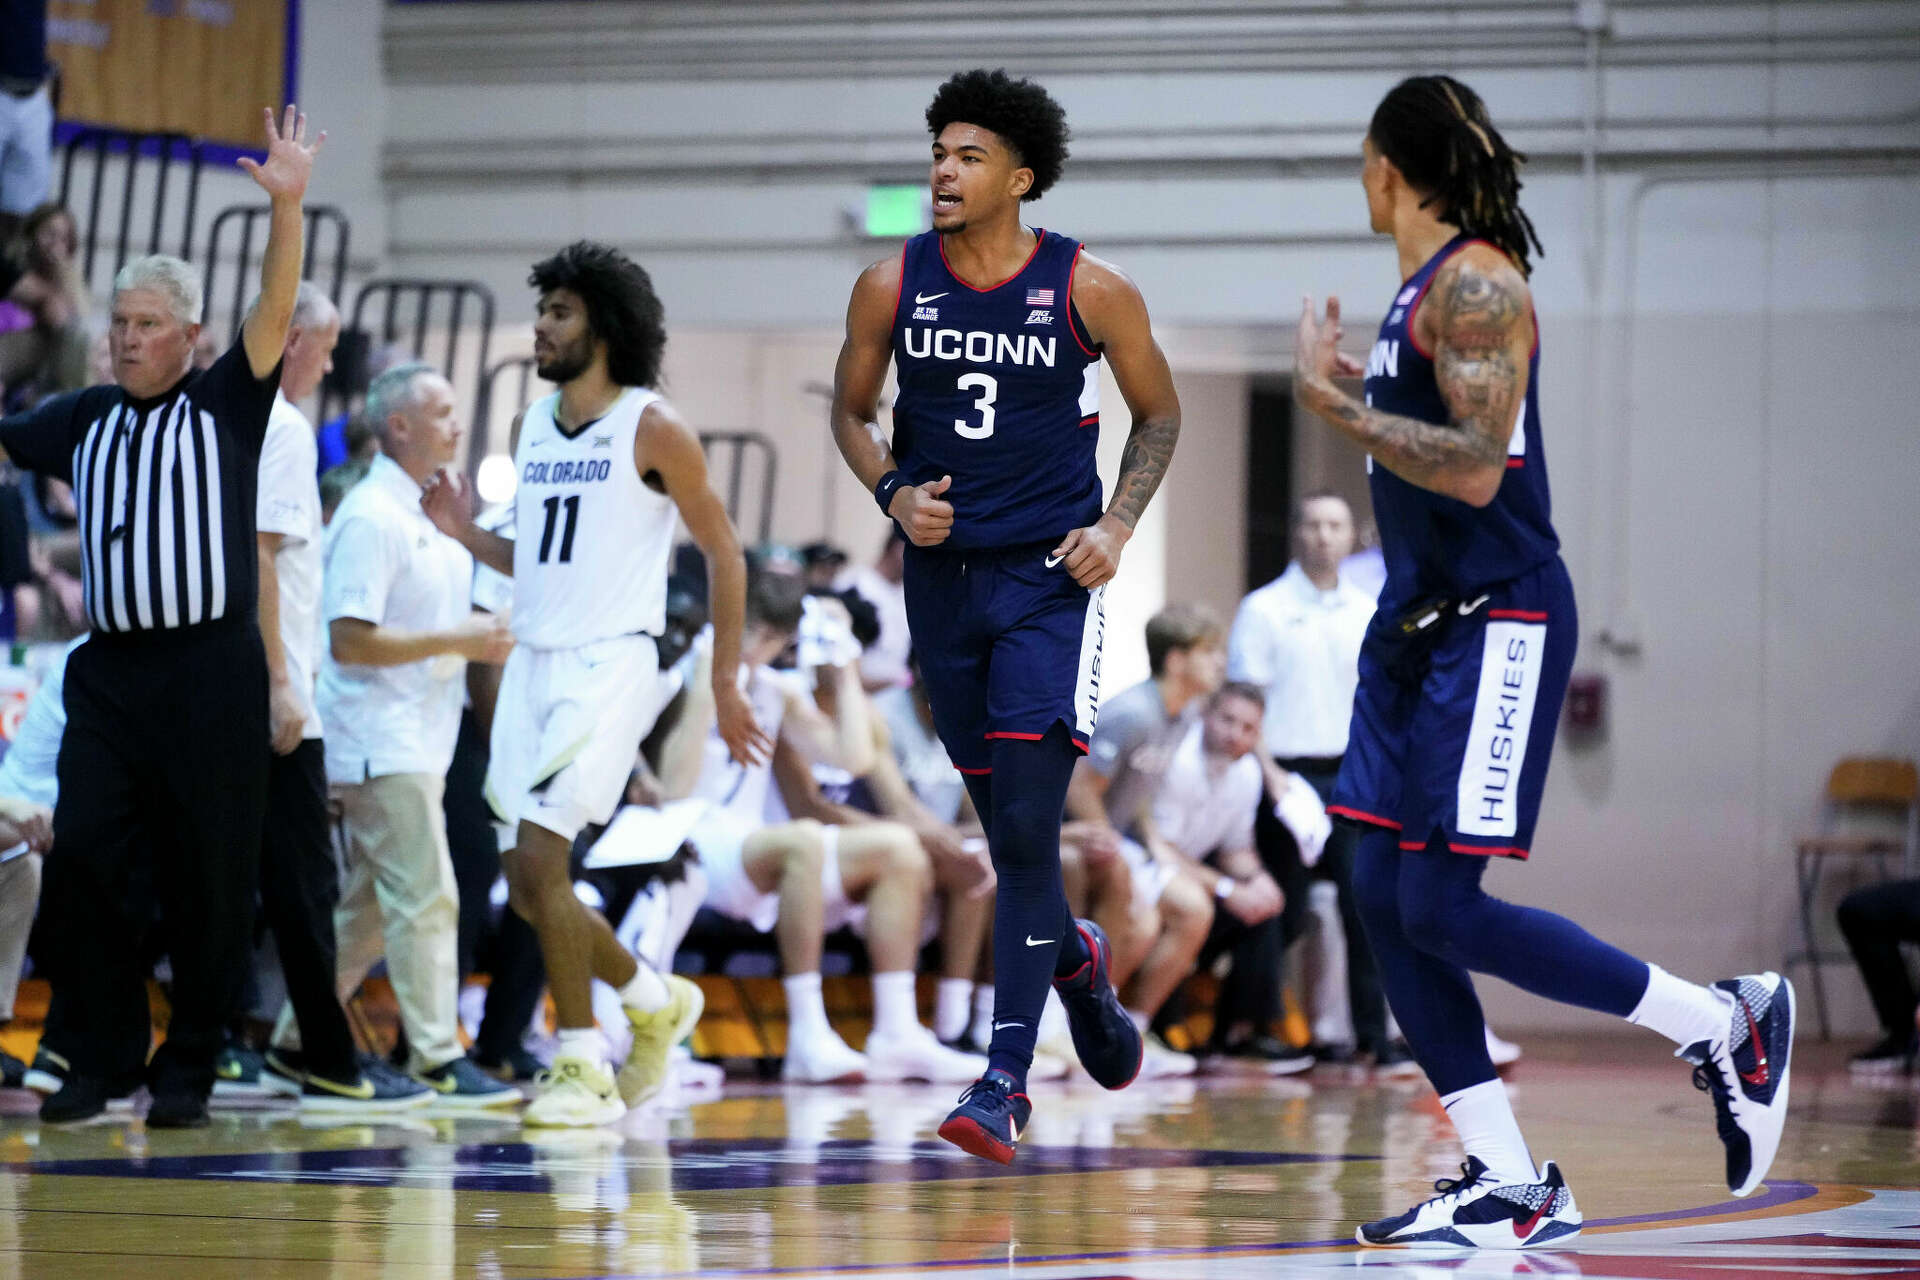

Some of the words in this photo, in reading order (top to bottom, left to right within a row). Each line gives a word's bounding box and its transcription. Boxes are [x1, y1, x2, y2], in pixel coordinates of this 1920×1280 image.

[912, 313, 939, 321] CHANGE
[904, 327, 1057, 367] UCONN
[954, 372, 998, 440] 3
[523, 459, 611, 484] COLORADO
[538, 495, 581, 564] 11
[1480, 638, 1527, 822] HUSKIES
